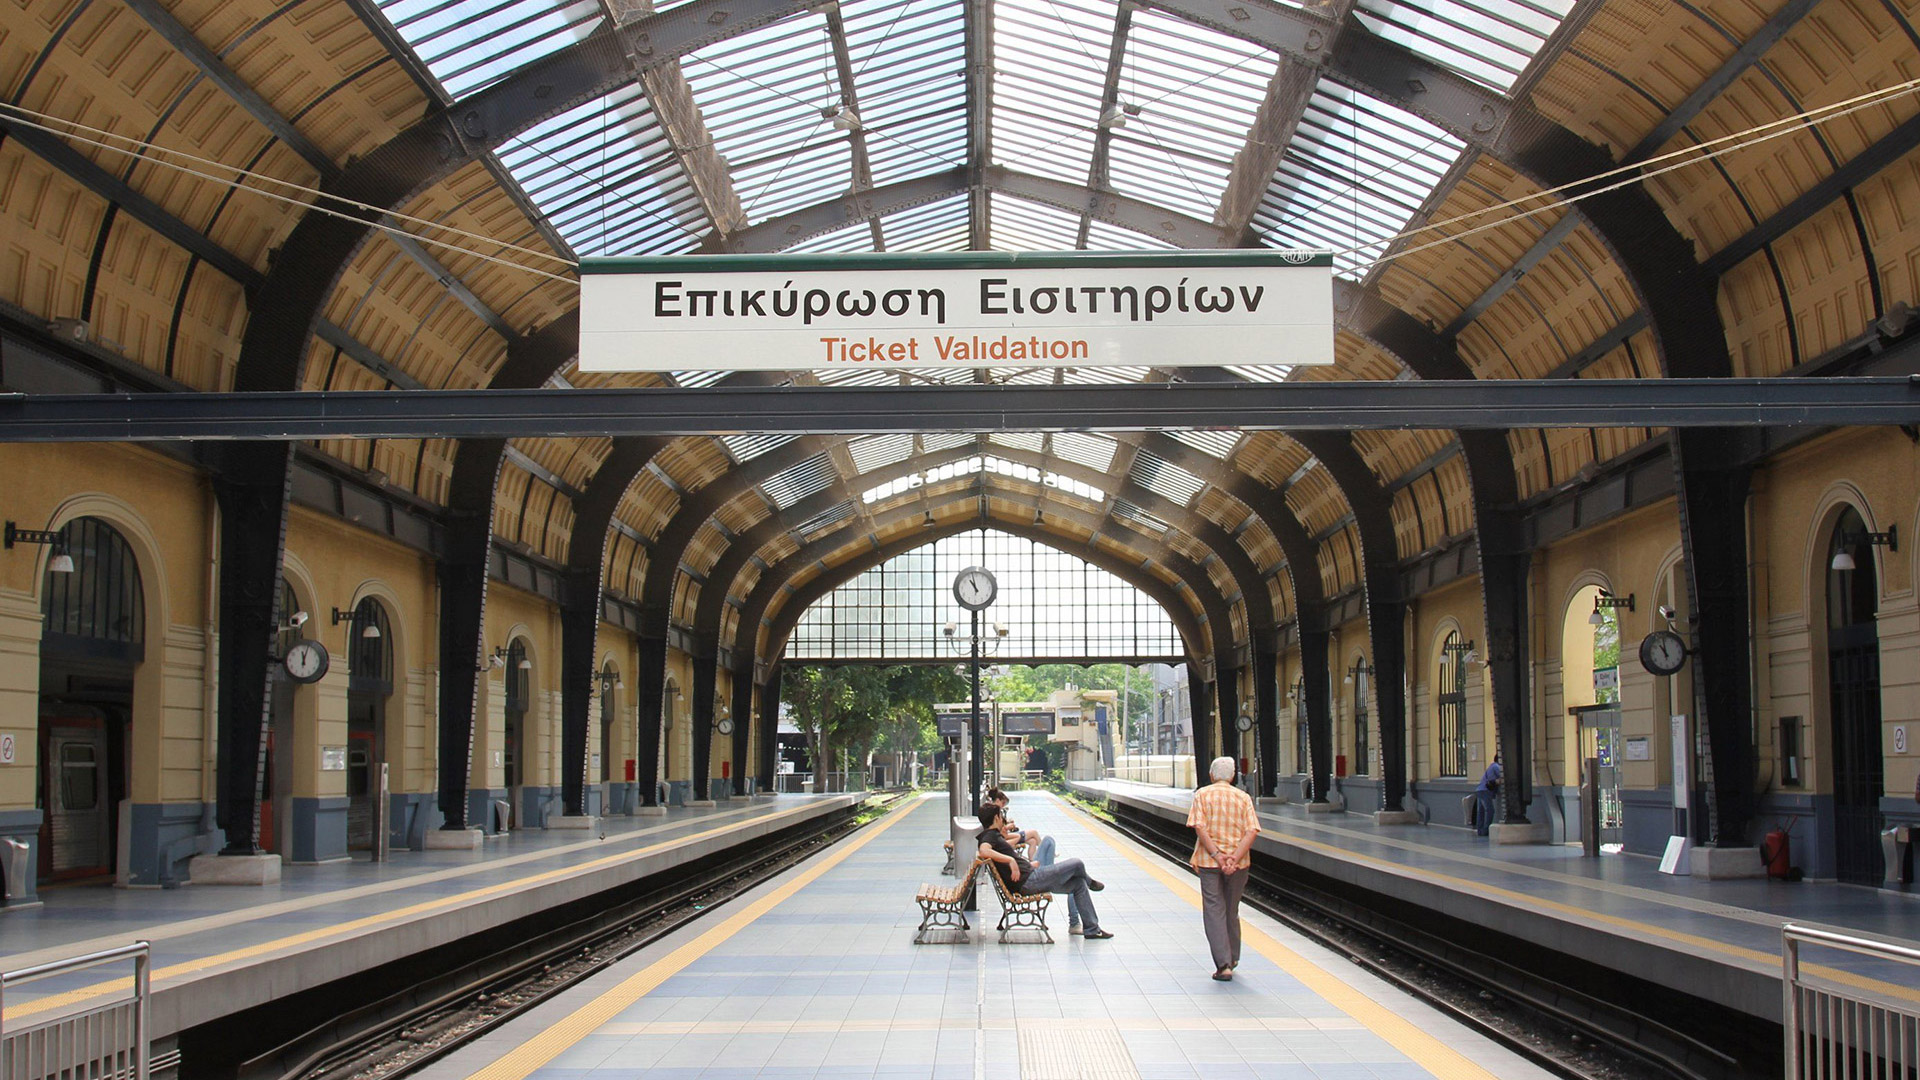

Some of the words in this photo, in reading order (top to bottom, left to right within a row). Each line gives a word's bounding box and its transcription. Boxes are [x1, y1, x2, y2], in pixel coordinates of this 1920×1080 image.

[654, 281, 946, 325] Επικύρωση
[980, 277, 1264, 322] Εισιτηρίων
[820, 337, 920, 362] Ticket
